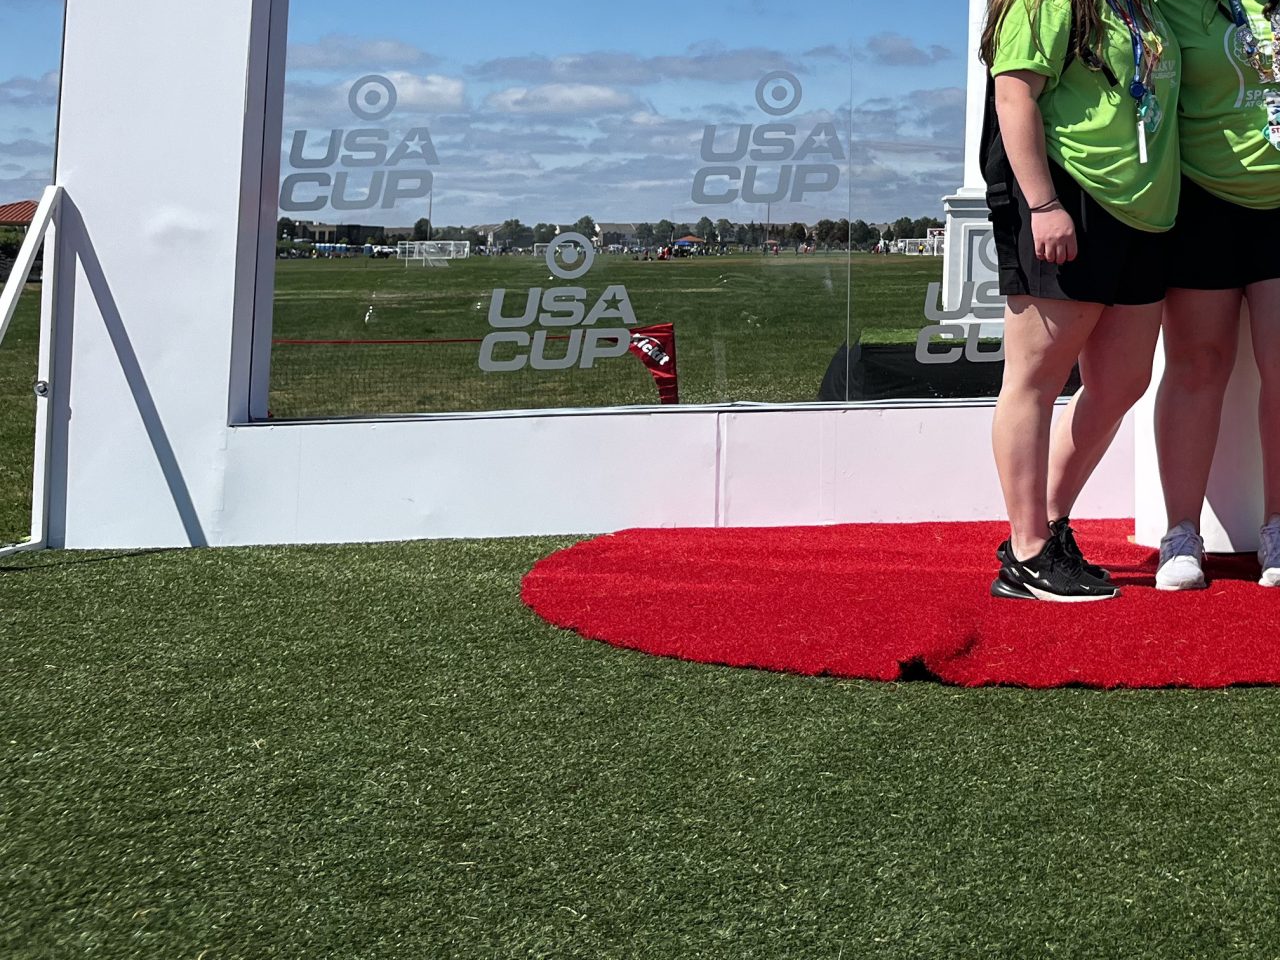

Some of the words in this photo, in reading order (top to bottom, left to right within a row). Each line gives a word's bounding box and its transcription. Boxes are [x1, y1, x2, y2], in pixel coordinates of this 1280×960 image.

[289, 127, 439, 168] USA
[700, 123, 845, 162] USA
[279, 170, 433, 211] CUP
[691, 164, 839, 204] CUP
[488, 285, 637, 327] USA
[924, 281, 1007, 320] US
[478, 330, 629, 372] CUP
[915, 324, 1006, 363] CU
